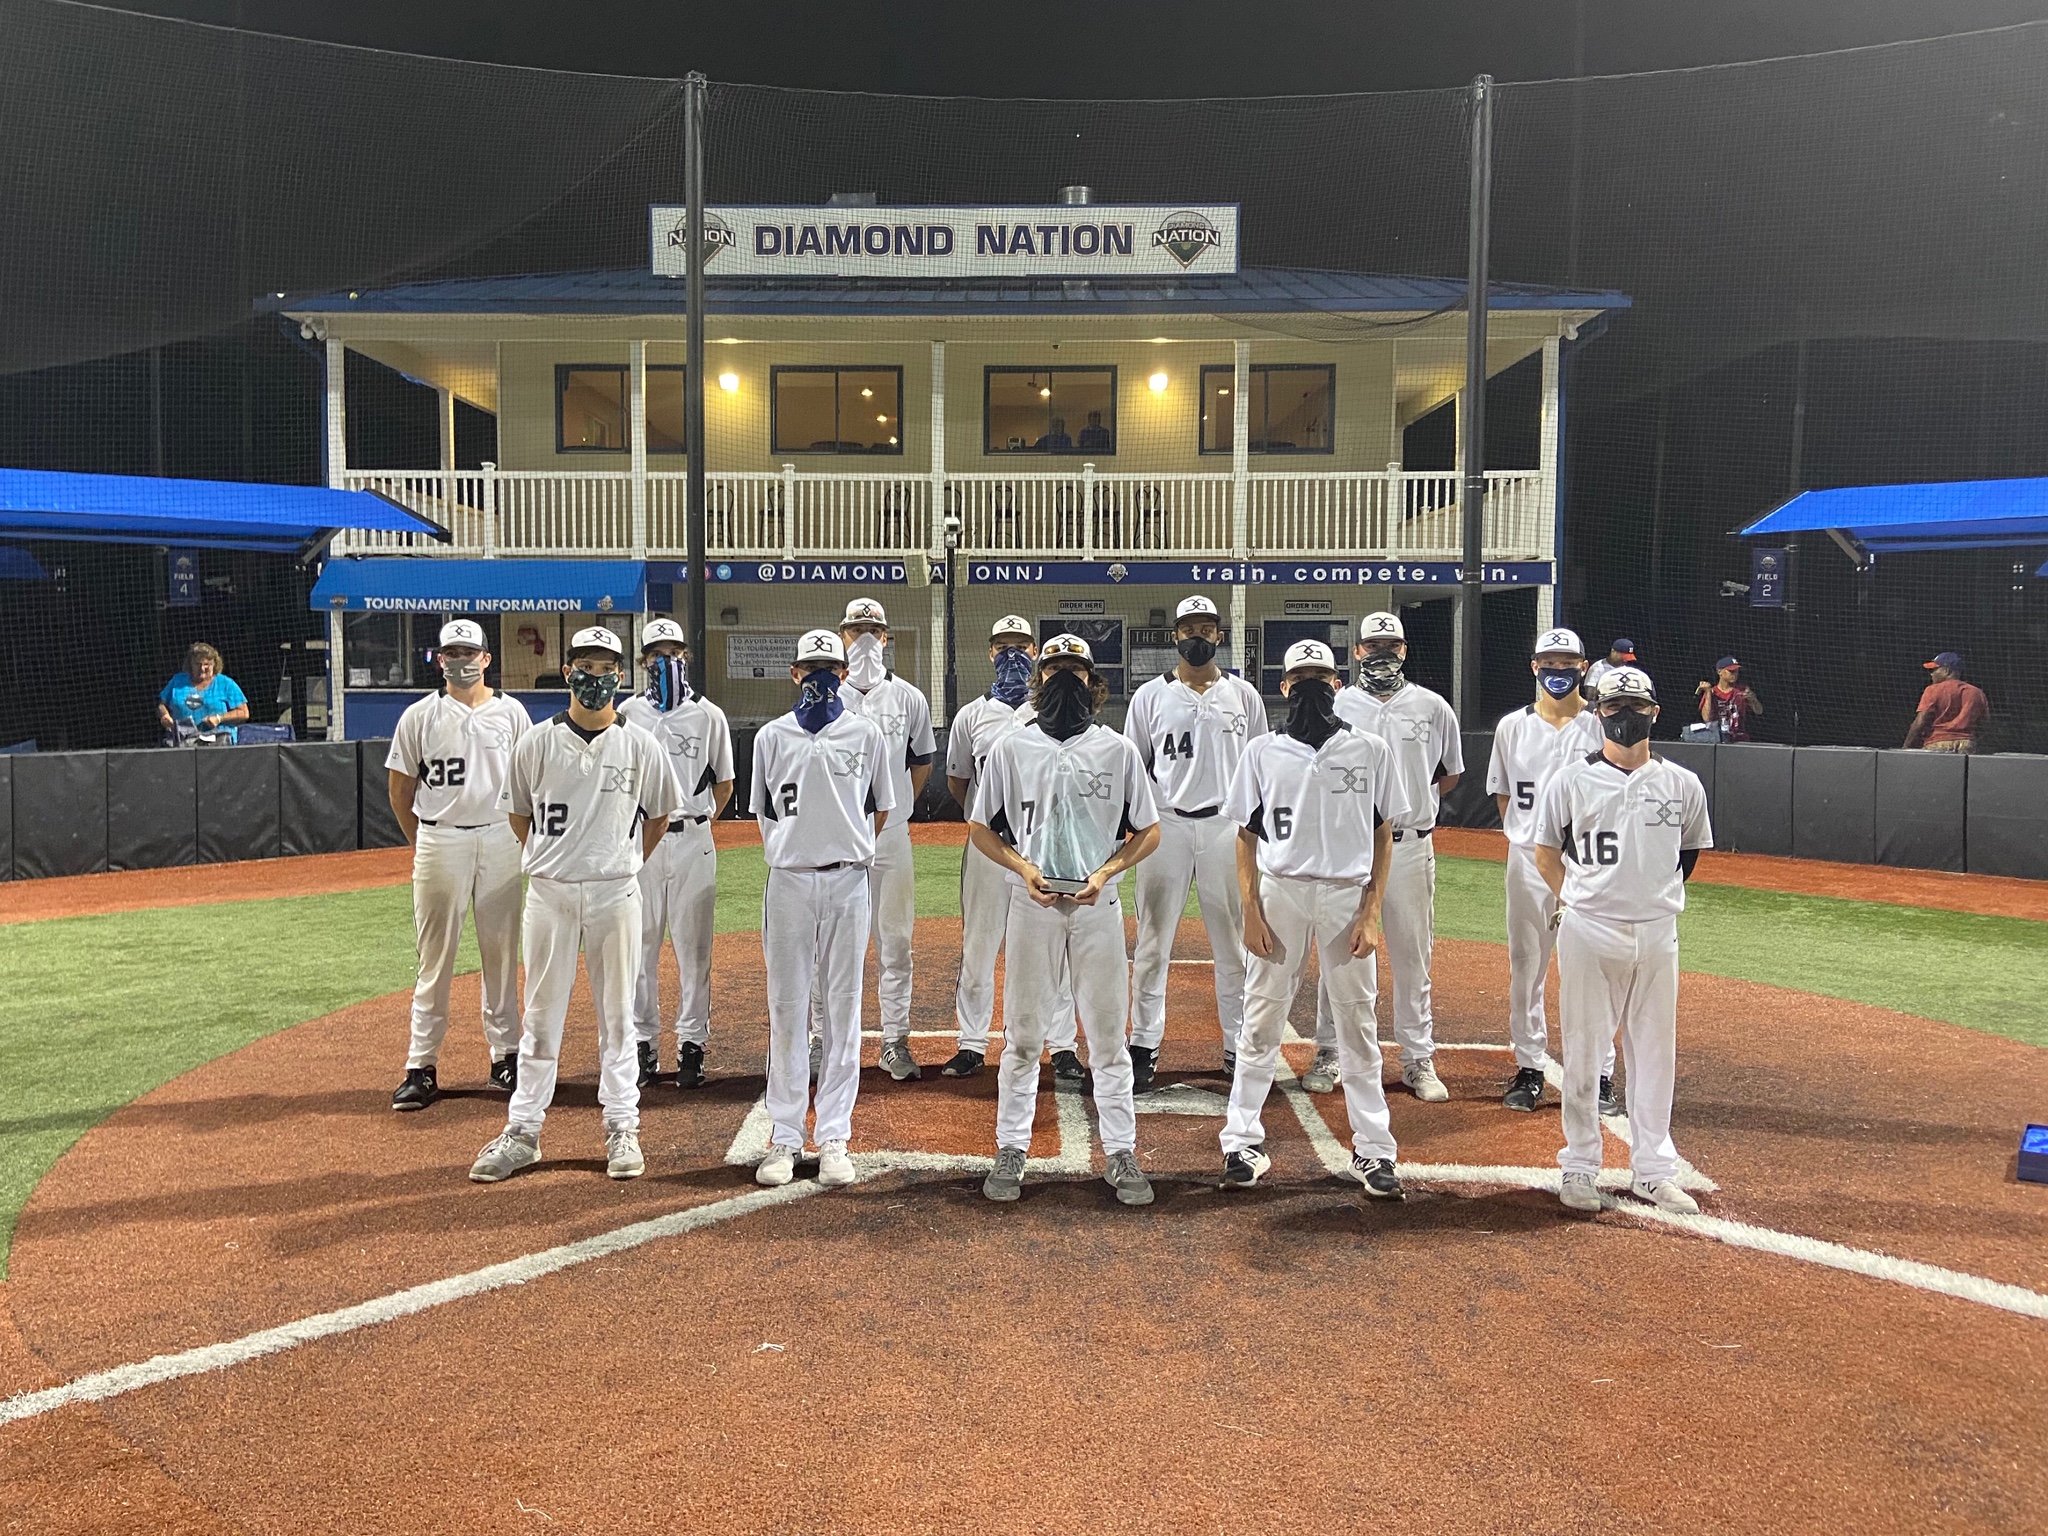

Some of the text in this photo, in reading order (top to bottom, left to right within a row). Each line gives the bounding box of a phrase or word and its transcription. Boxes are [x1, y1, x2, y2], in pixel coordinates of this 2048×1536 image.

[669, 229, 735, 246] NION
[755, 225, 1134, 256] DIAMOND NATION
[1153, 229, 1220, 246] NATION
[1191, 564, 1277, 581] train.
[1294, 565, 1438, 584] compete.
[180, 583, 188, 596] 4
[364, 597, 469, 611] TOURNAMENT
[475, 598, 582, 611] INFORMATION
[1762, 584, 1772, 597] 2
[1135, 631, 1157, 643] THE
[1163, 731, 1193, 761] 44
[430, 757, 465, 787] 32
[781, 783, 798, 817] 2
[1516, 781, 1535, 810] 5
[539, 803, 568, 837] 12
[1021, 800, 1035, 835] 7
[1273, 806, 1292, 841] 6
[1582, 831, 1618, 866] 16
